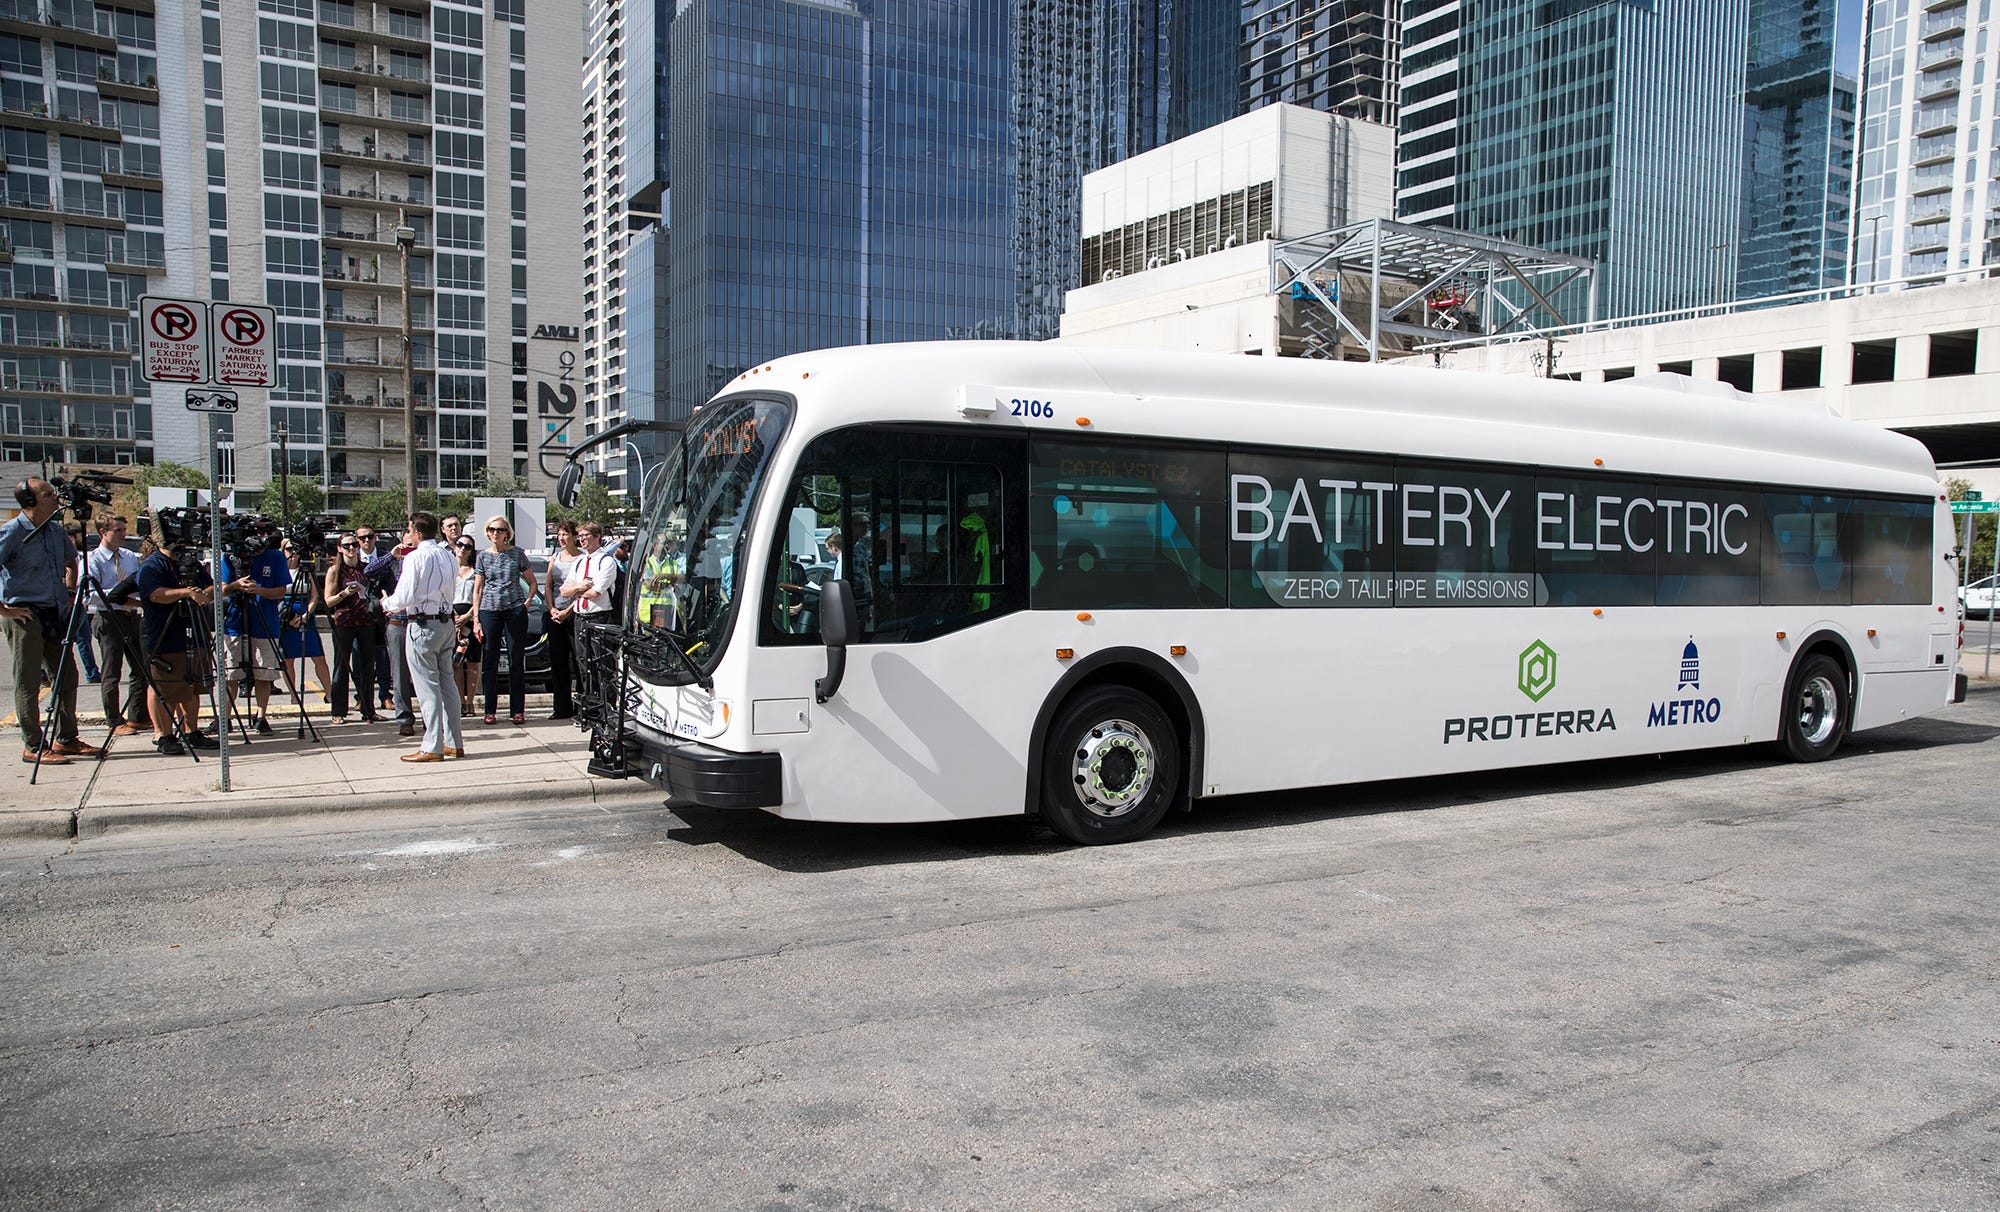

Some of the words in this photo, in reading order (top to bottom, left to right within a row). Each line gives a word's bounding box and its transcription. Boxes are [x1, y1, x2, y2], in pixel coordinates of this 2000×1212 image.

[149, 341, 170, 349] BUS
[174, 343, 200, 351] STOP
[156, 350, 193, 358] EXCEPT
[222, 346, 265, 356] FARMERS
[149, 356, 201, 366] SATURDAY
[219, 360, 268, 370] SATURDAY
[225, 354, 262, 363] MARKET
[559, 350, 576, 380] ON
[1011, 398, 1054, 419] 2106
[1060, 458, 1157, 481] CATALYST
[1231, 474, 1512, 547] BATTERY
[1537, 491, 1749, 555] ELECTRIC
[1284, 578, 1340, 599] ZERO
[1347, 578, 1427, 599] TAILPIPE
[1435, 579, 1529, 599] EMISSIONS
[1647, 697, 1721, 727] METRO
[679, 722, 699, 737] METRO
[1443, 708, 1617, 744] PROTERRA
